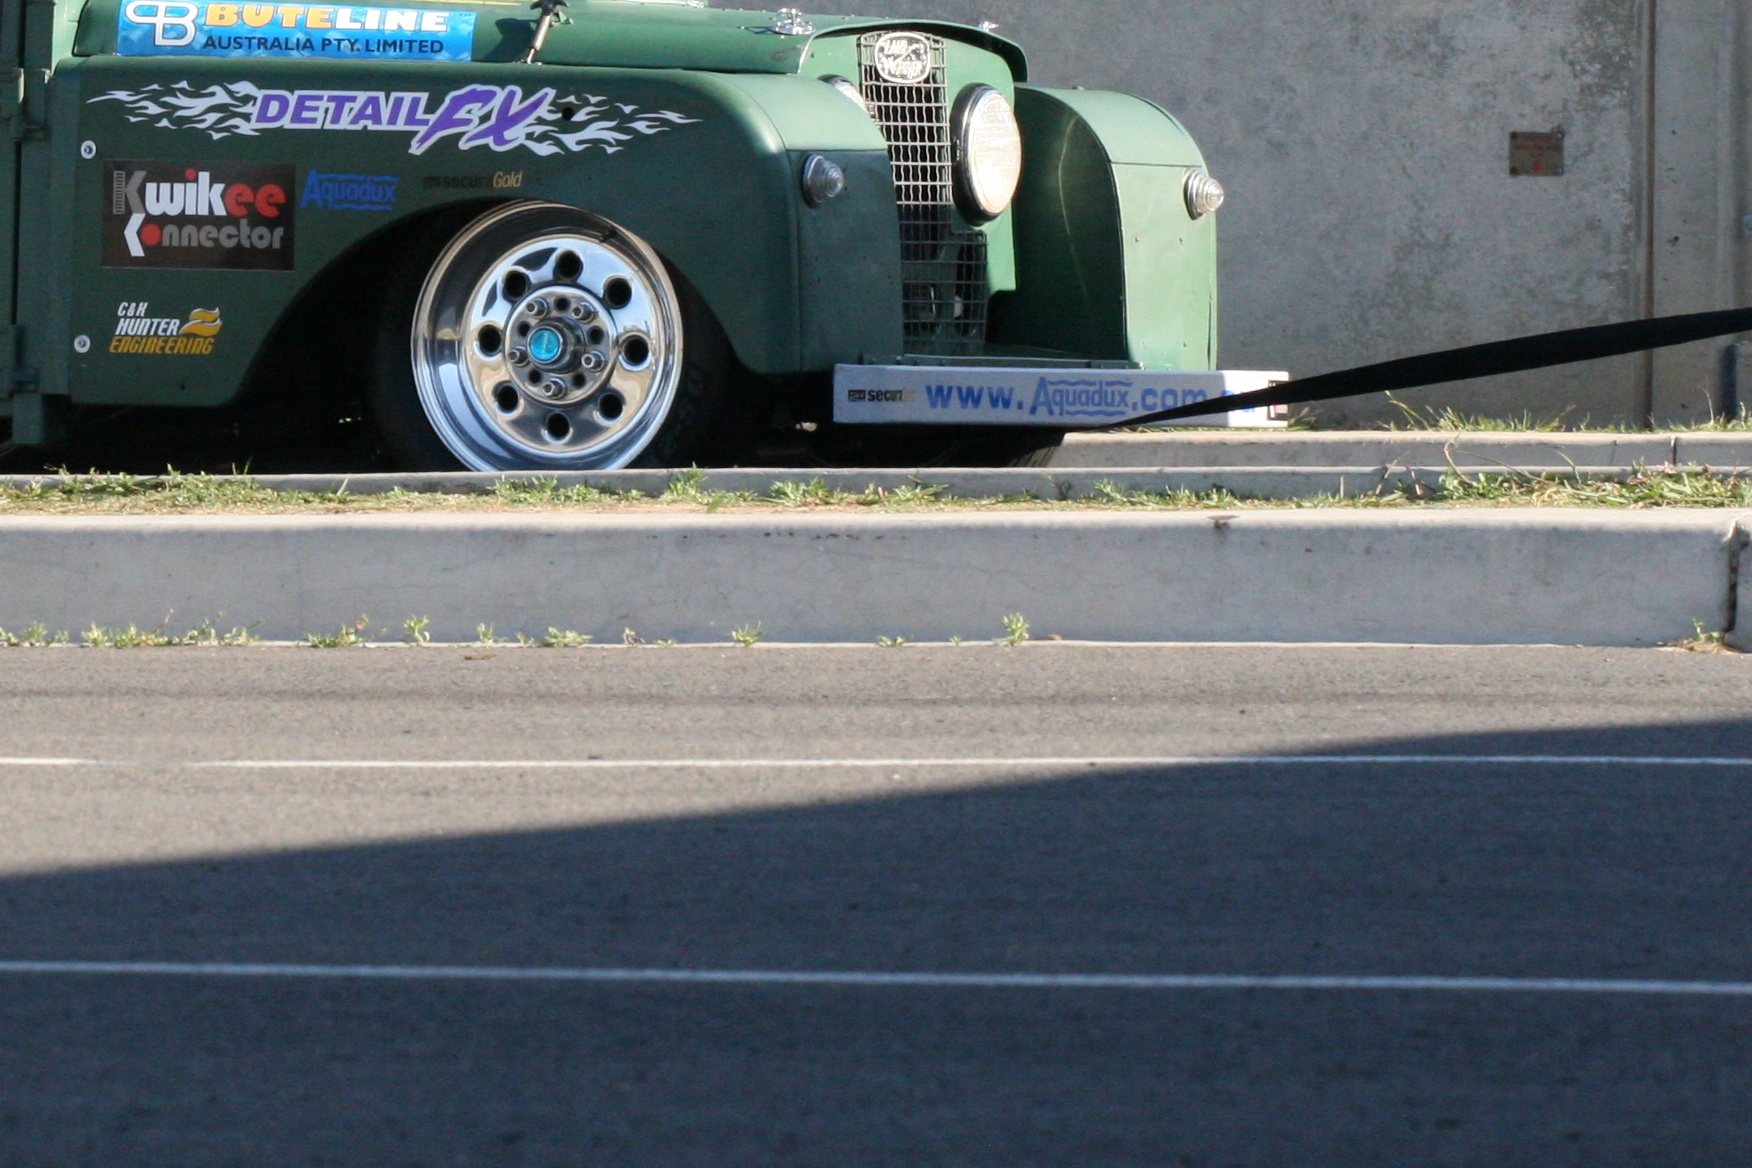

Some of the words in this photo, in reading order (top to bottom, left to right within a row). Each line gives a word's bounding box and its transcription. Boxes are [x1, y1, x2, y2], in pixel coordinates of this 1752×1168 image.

[204, 2, 450, 33] BUTELINE
[203, 36, 315, 52] AUSTRALIA
[321, 38, 360, 53] PTY.
[365, 39, 444, 54] LIMITED
[493, 171, 523, 188] Gold
[113, 168, 288, 218] Kwikee
[299, 169, 397, 210] Aquadux
[117, 301, 148, 317] C&H
[115, 318, 180, 336] HUNTER
[108, 336, 214, 355] ENGINEERING
